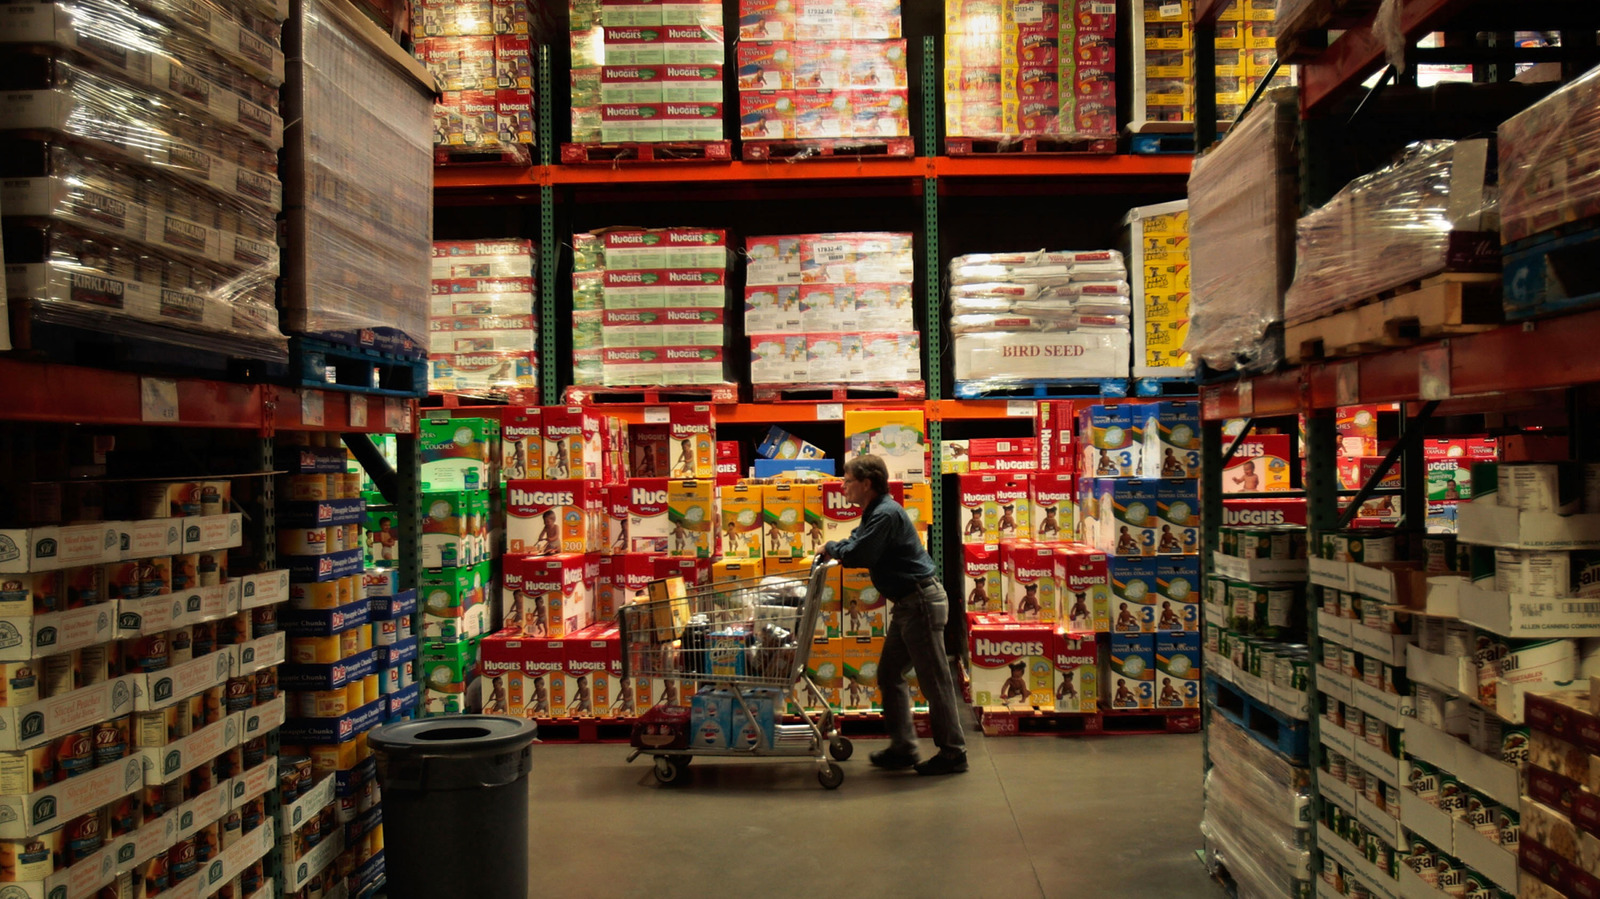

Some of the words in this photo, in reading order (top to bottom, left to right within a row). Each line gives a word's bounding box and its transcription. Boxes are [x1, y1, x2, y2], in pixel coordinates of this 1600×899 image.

[609, 30, 641, 40] HUGGIES
[669, 29, 701, 38] HUGGIES
[607, 70, 639, 78] HUGGIES
[667, 68, 700, 77] HUGGIES
[607, 108, 639, 116] HUGGIES
[667, 106, 700, 115] HUGGIES
[611, 235, 643, 244] HUGGIES
[671, 233, 703, 242] HUGGIES
[475, 244, 520, 256] HUGGIES
[610, 274, 642, 282] HUGGIES
[670, 272, 702, 281] HUGGIES
[73, 273, 123, 296] KIRKLAND
[477, 281, 521, 292] HUGGIES
[608, 313, 640, 322] HUGGIES
[668, 312, 700, 320] HUGGIES
[479, 318, 523, 329] HUGGIES
[608, 351, 640, 360] HUGGIES
[667, 350, 700, 358] HUGGIES
[1002, 346, 1040, 358] BIRD
[1044, 345, 1084, 356] SEED
[456, 356, 498, 366] HUGGIES
[506, 426, 540, 435] HUGGIES
[548, 426, 582, 435] HUGGIES
[673, 424, 709, 434] HUGGIES
[1041, 429, 1052, 470] HUGGIES
[1120, 451, 1132, 468] 3
[1186, 452, 1200, 468] 3
[717, 464, 737, 473] GIES
[996, 460, 1034, 470] HUGGIES
[1428, 462, 1458, 471] UGGIES
[510, 489, 574, 506] HUGGIES
[964, 493, 996, 502] HUGGIES
[997, 491, 1027, 499] HUGGIES
[1038, 492, 1070, 500] HUGGIES
[319, 504, 332, 519] Dole
[307, 532, 326, 542] Dole
[1142, 530, 1154, 546] 3
[1184, 528, 1196, 546] 3
[564, 542, 582, 550] 200
[320, 558, 332, 574] Dole
[967, 562, 998, 571] HUGGIES
[1018, 568, 1052, 577] HUGGIES
[367, 574, 388, 585] Dole
[628, 575, 654, 584] HUGGI
[1070, 576, 1106, 584] HUGGIES
[525, 581, 562, 590] HUGGIES
[1141, 606, 1154, 623] 3
[1184, 605, 1197, 622] 3
[333, 610, 344, 628] Dole
[976, 638, 1044, 656] HUGGIES
[1058, 654, 1094, 664] HUGGIES
[484, 661, 521, 670] HUGGIES
[526, 661, 563, 671] HUGGIES
[569, 660, 606, 670] HUGGIES
[333, 664, 346, 683] Dole
[1139, 682, 1152, 699] 3
[1184, 682, 1198, 698] 3
[1032, 693, 1050, 702] 224
[55, 703, 74, 717] Sliced
[340, 718, 352, 736] Dole
